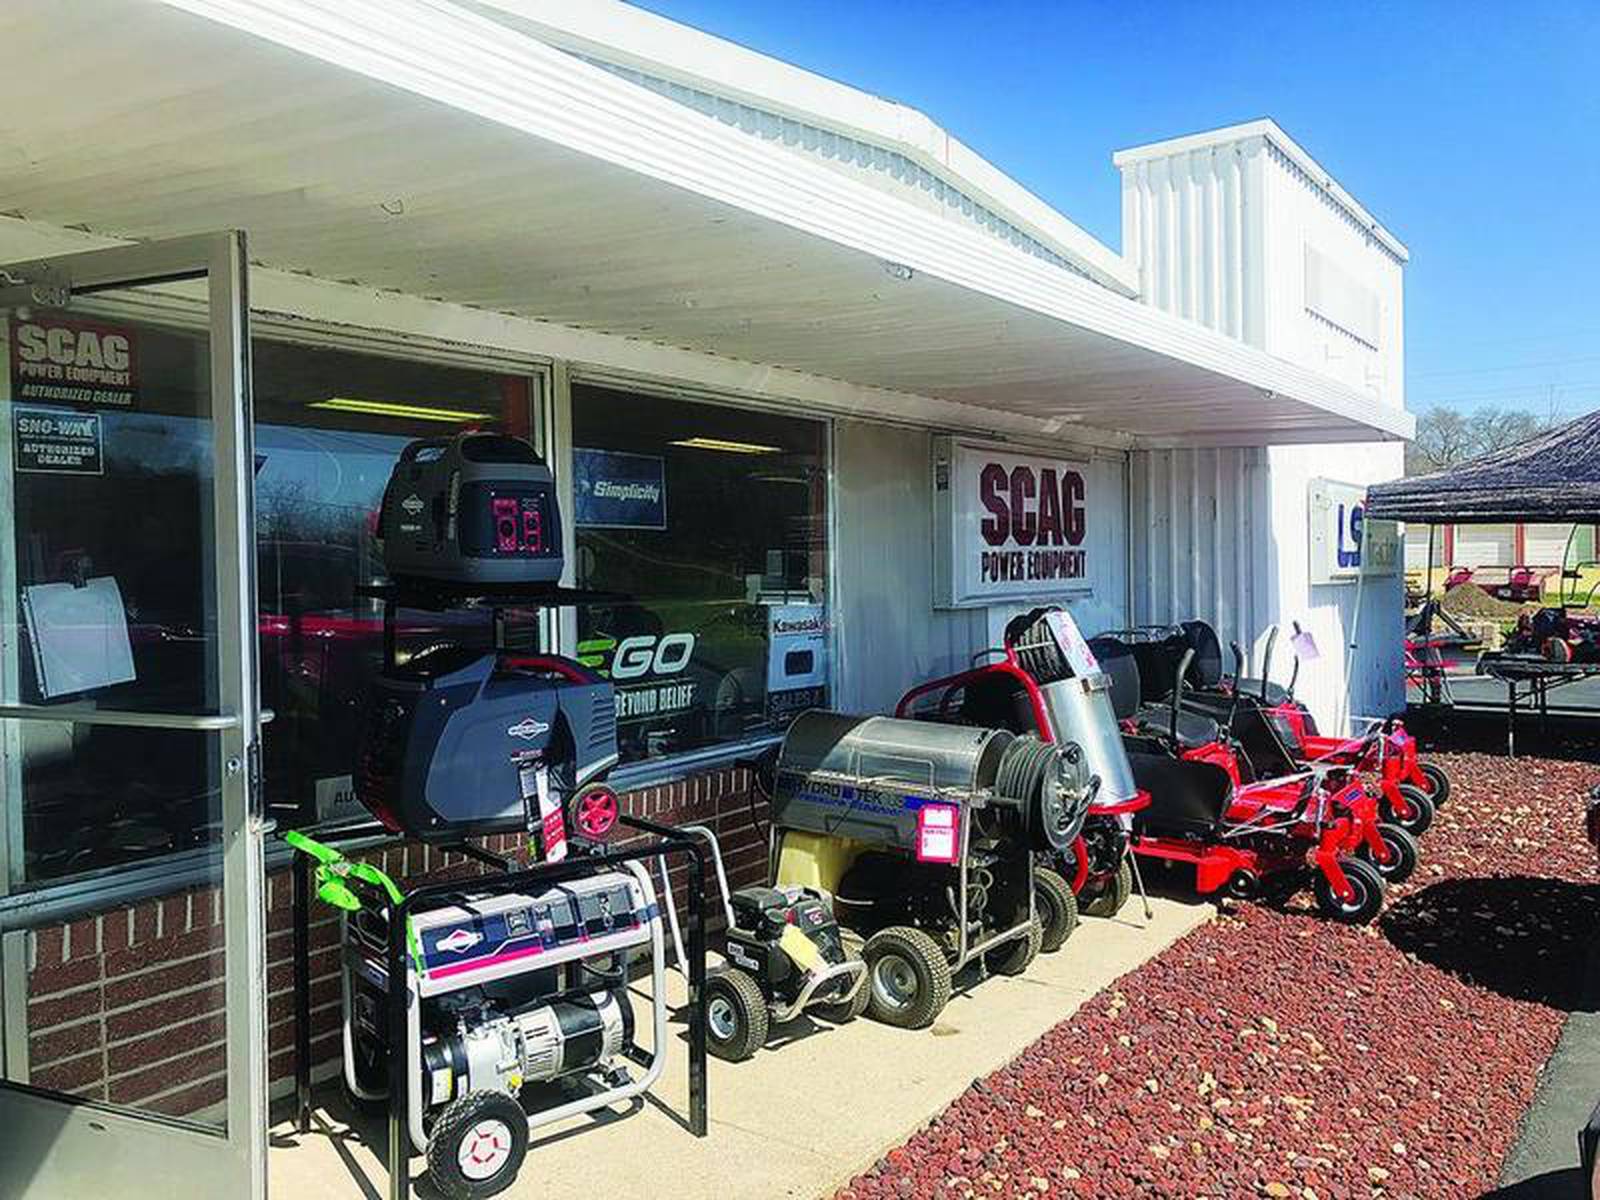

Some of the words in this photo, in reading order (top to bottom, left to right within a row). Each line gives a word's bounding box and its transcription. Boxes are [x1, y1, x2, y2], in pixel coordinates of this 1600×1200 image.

[17, 325, 129, 370] SCAG
[19, 363, 63, 379] POWER
[66, 366, 130, 384] EQUIPMENT
[22, 384, 92, 401] AUTHORIZED
[92, 390, 132, 405] DEALER
[593, 481, 660, 503] Simplicity
[980, 463, 1086, 546] SCAG
[981, 551, 1024, 582] POWER
[1027, 550, 1086, 580] EQUIPMENT
[660, 684, 693, 711] BELIEF
